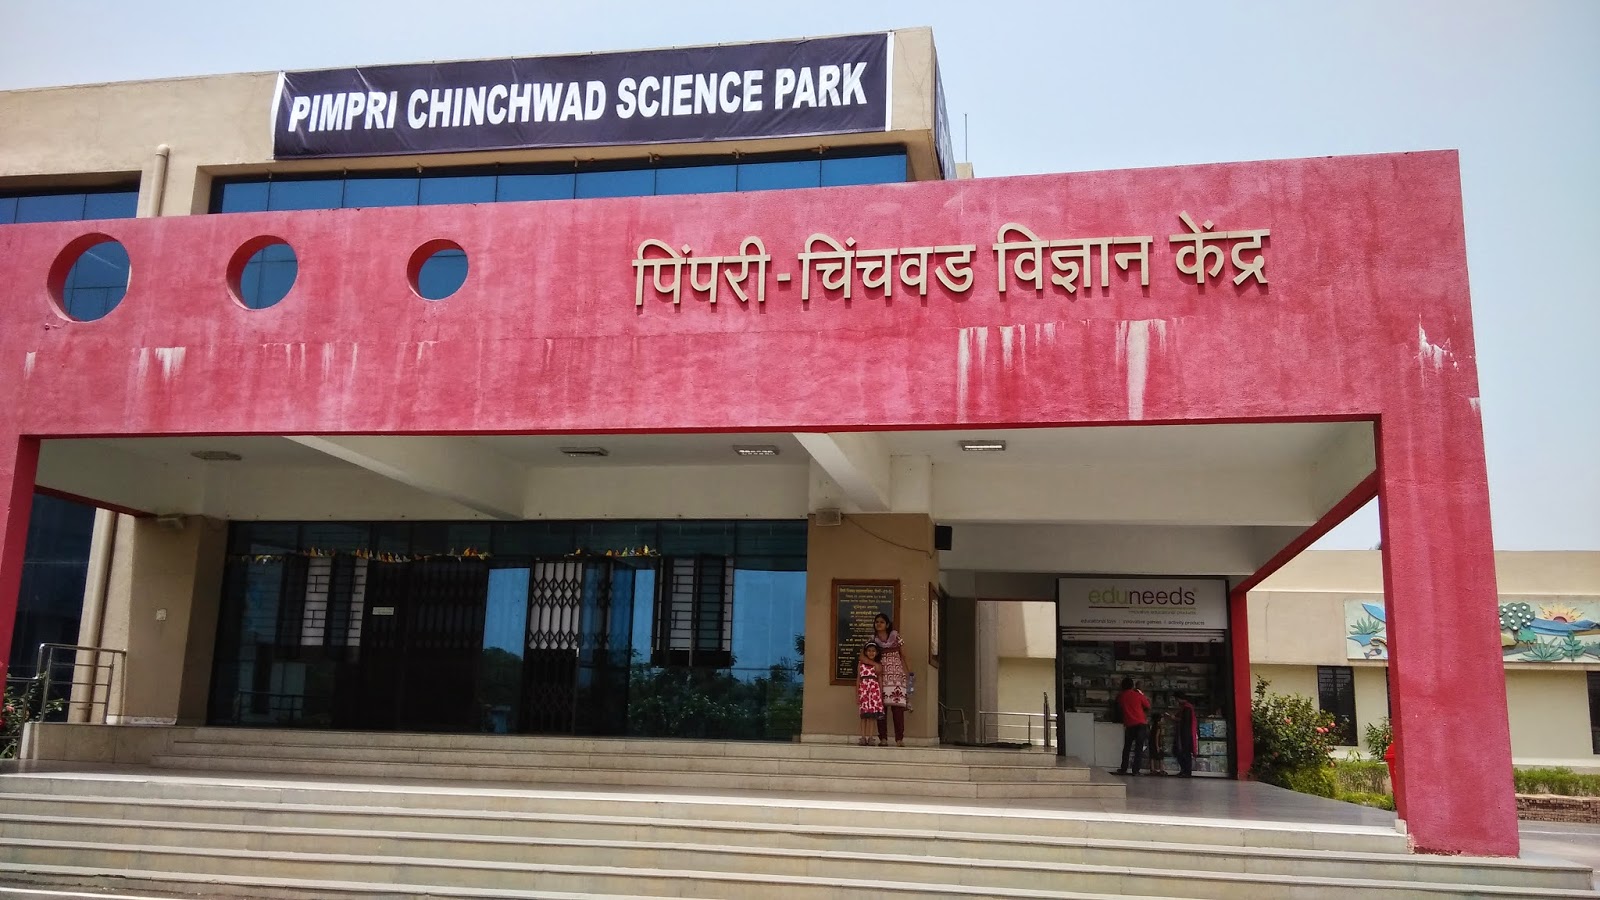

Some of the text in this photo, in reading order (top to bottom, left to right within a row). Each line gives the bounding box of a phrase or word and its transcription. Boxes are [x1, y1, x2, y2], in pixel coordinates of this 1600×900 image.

[287, 61, 868, 133] PIMPRI CHINCHWAD SCIENCE PARK
[992, 222, 1154, 296] विज्ञान
[1168, 210, 1271, 288] केंद्र
[1088, 586, 1196, 605] eduneeds
